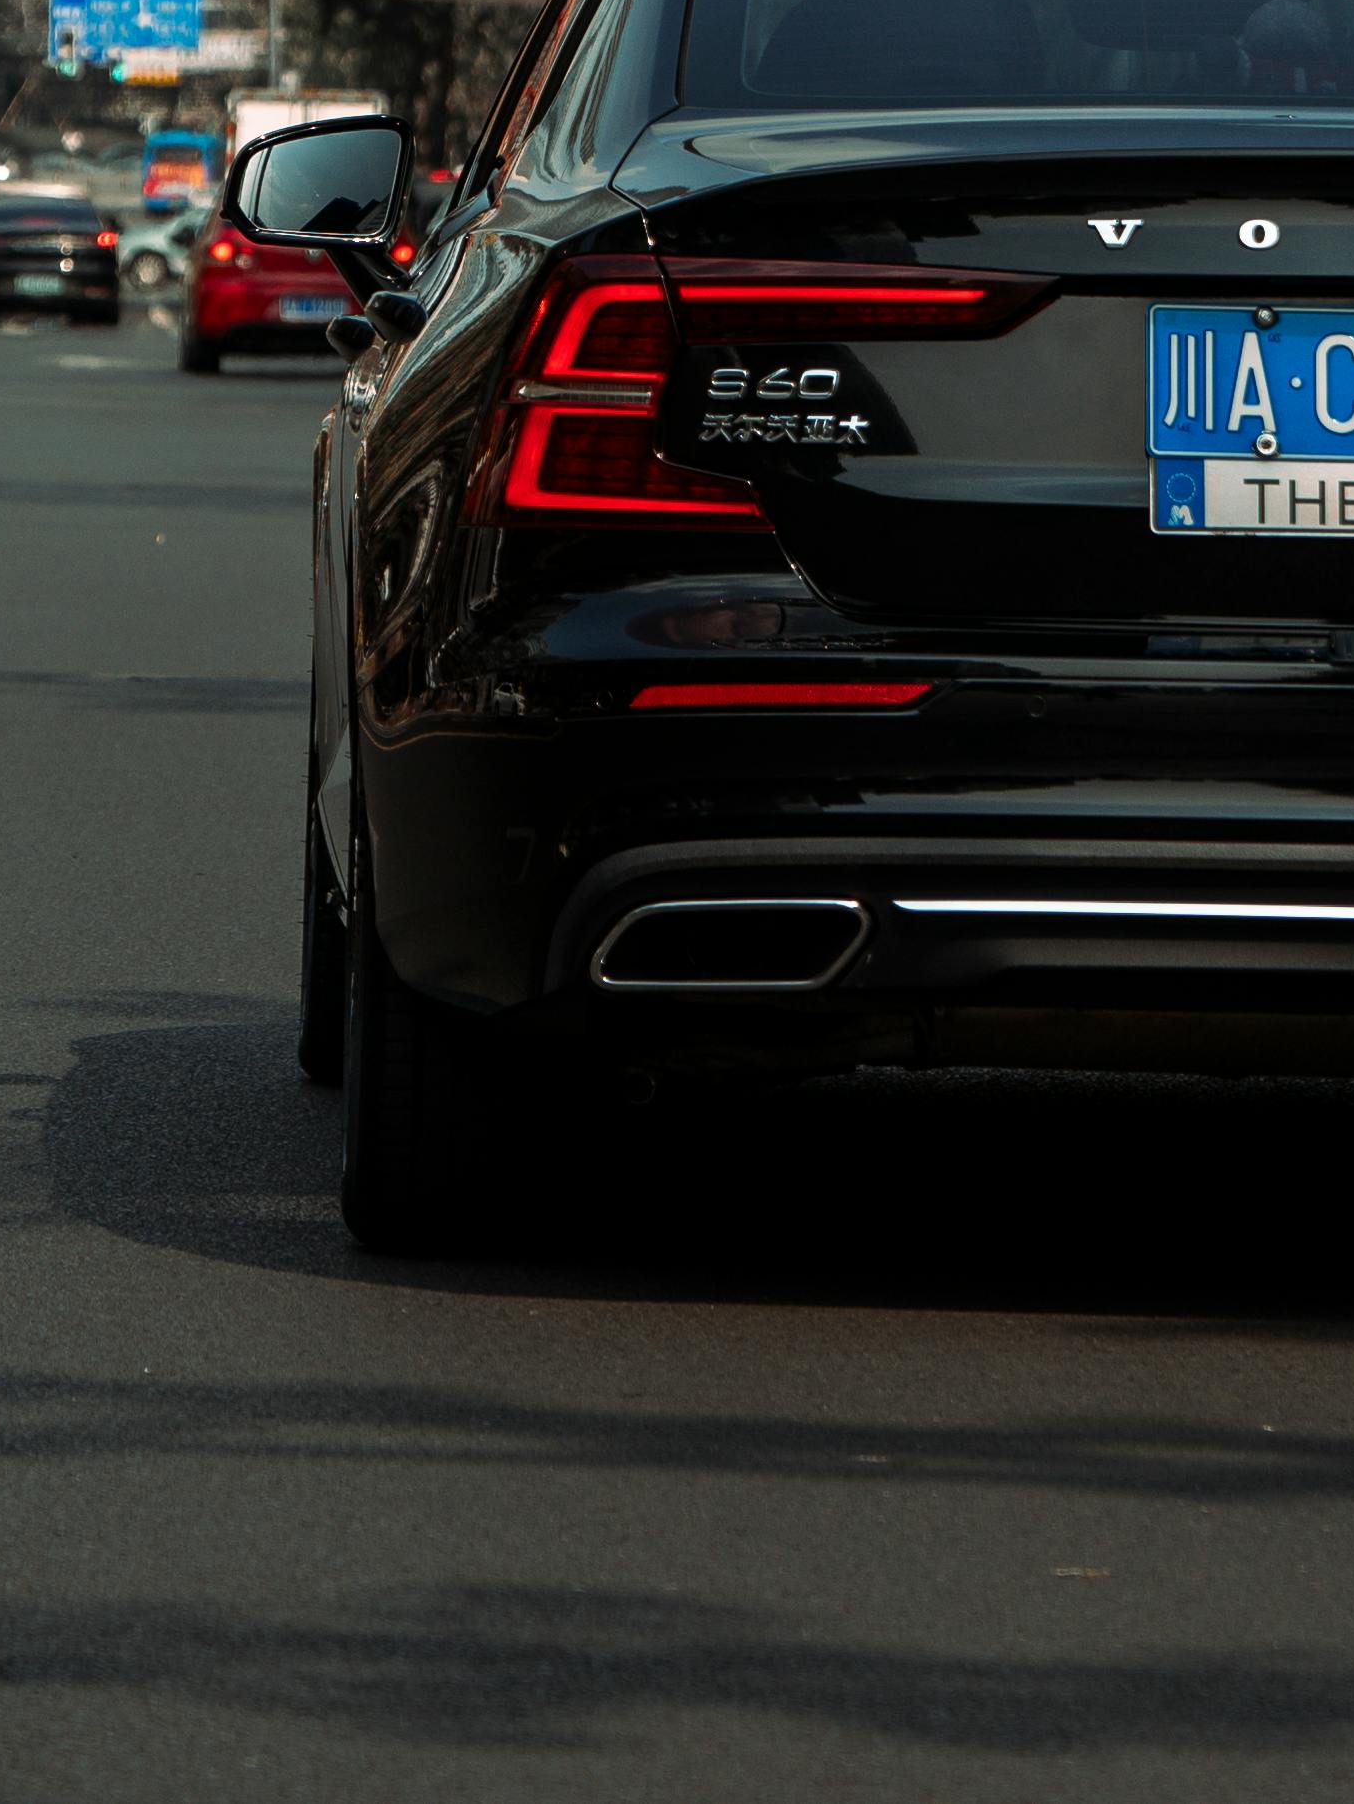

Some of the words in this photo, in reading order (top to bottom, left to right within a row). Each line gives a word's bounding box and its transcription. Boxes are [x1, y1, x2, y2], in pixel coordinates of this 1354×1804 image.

[707, 368, 840, 400] S60
[699, 414, 871, 444] 沃尔沃亚太
